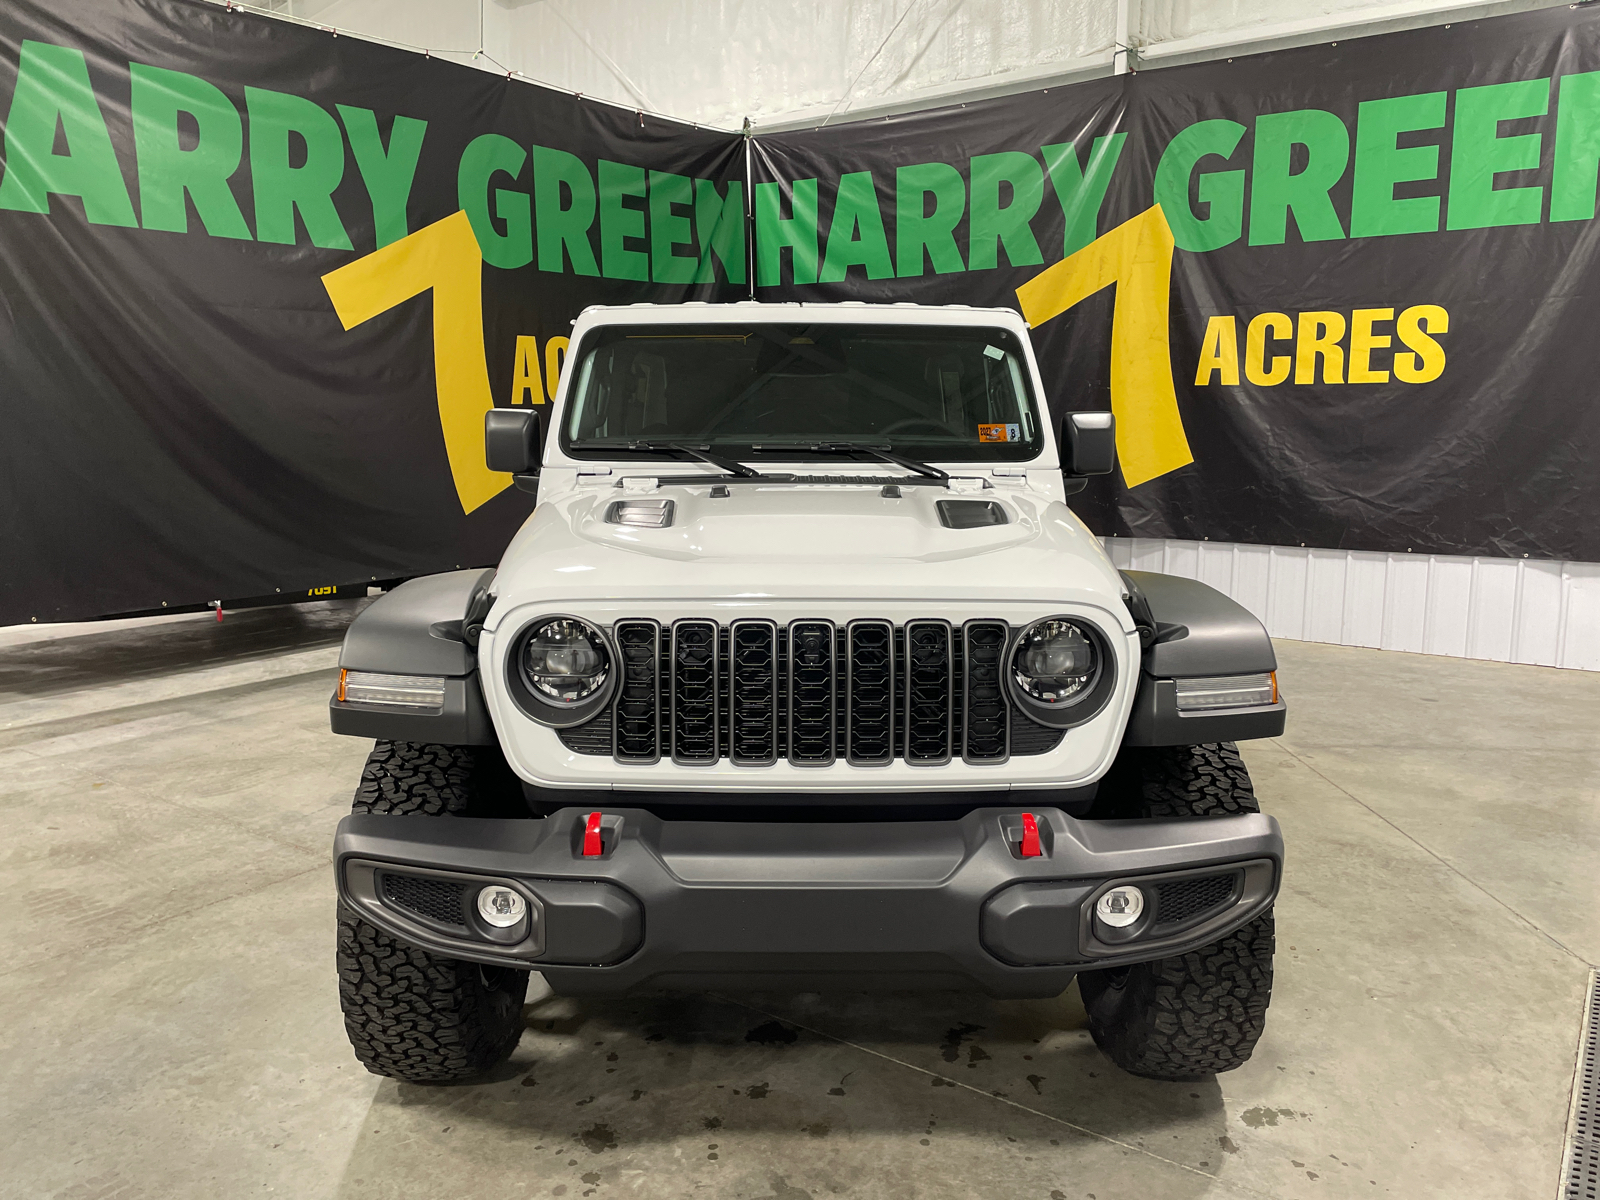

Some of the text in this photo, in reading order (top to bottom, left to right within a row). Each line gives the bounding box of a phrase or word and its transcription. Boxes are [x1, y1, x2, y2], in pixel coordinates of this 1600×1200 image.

[458, 133, 746, 284] GREEN
[755, 132, 1127, 287] HARRY
[321, 210, 514, 515] 7
[1015, 204, 1448, 488] 7 ACRES
